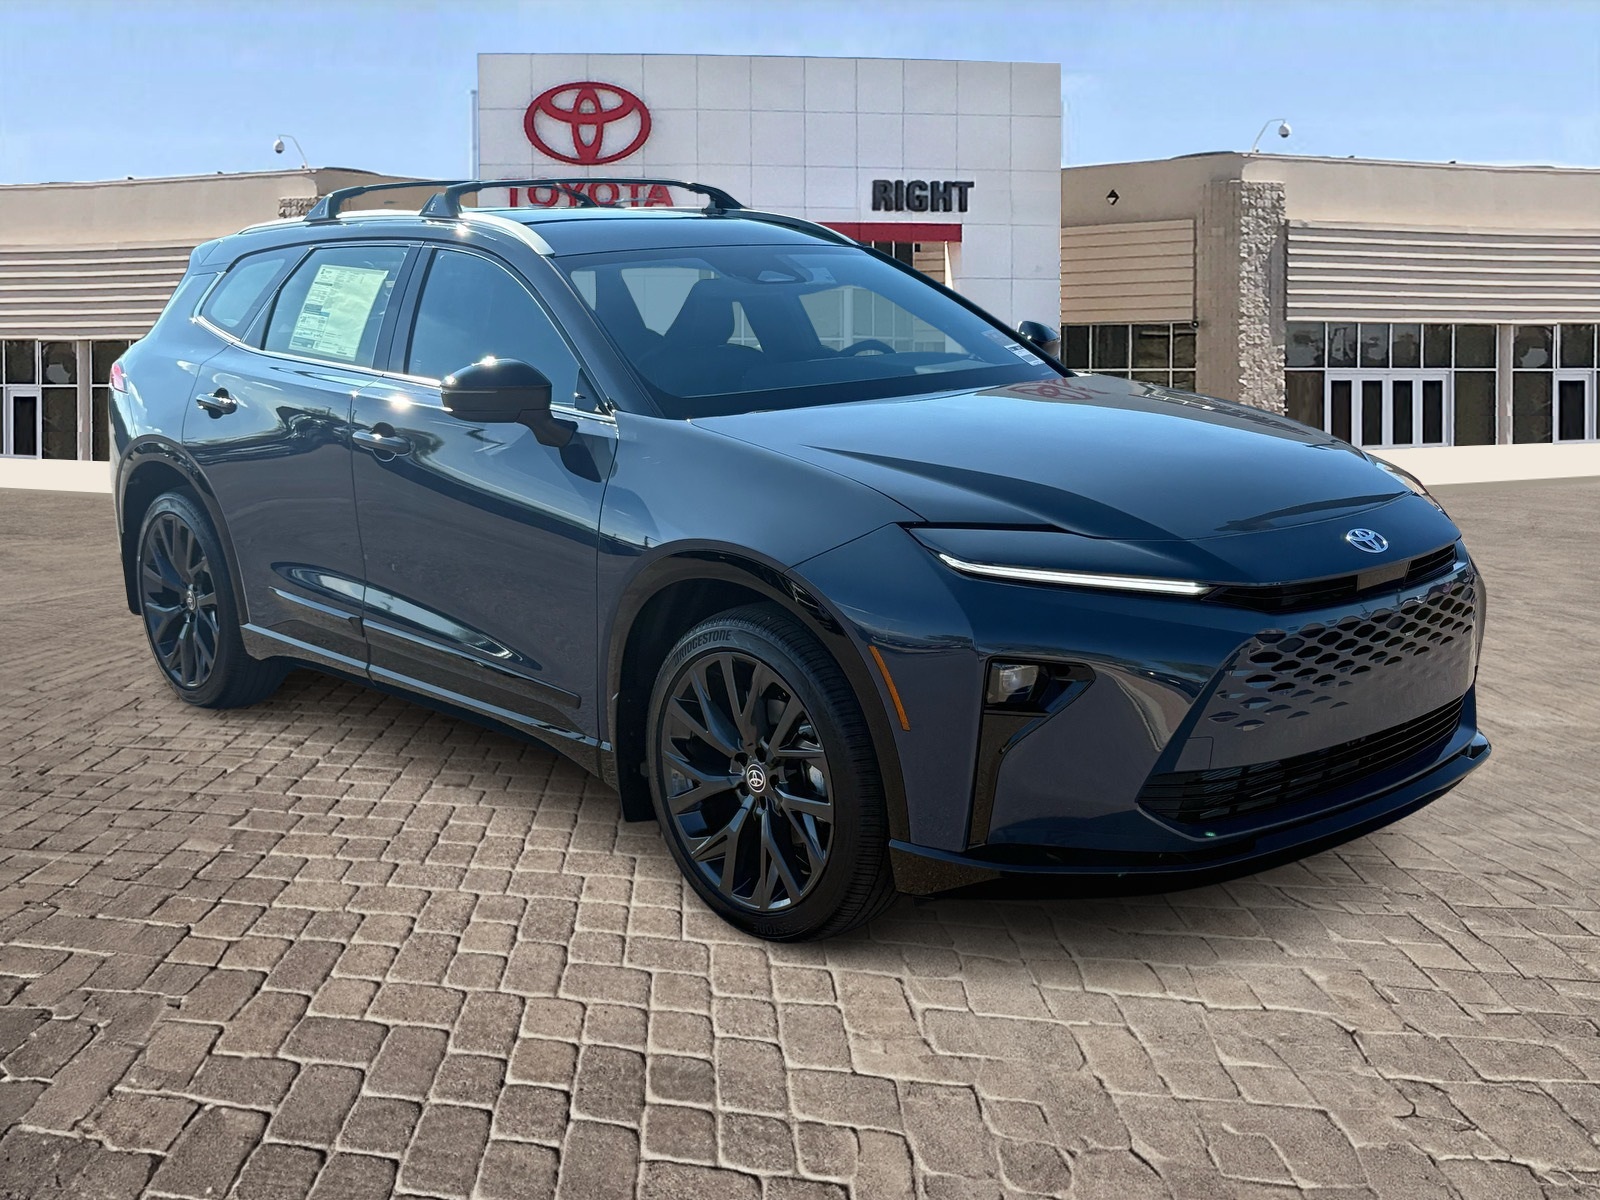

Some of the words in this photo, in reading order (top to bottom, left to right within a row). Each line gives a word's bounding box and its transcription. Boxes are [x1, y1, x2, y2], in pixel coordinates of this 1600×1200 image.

[501, 179, 674, 208] TOYOTA
[872, 180, 975, 212] RIGHT
[673, 629, 733, 667] BRIDGESTONE
